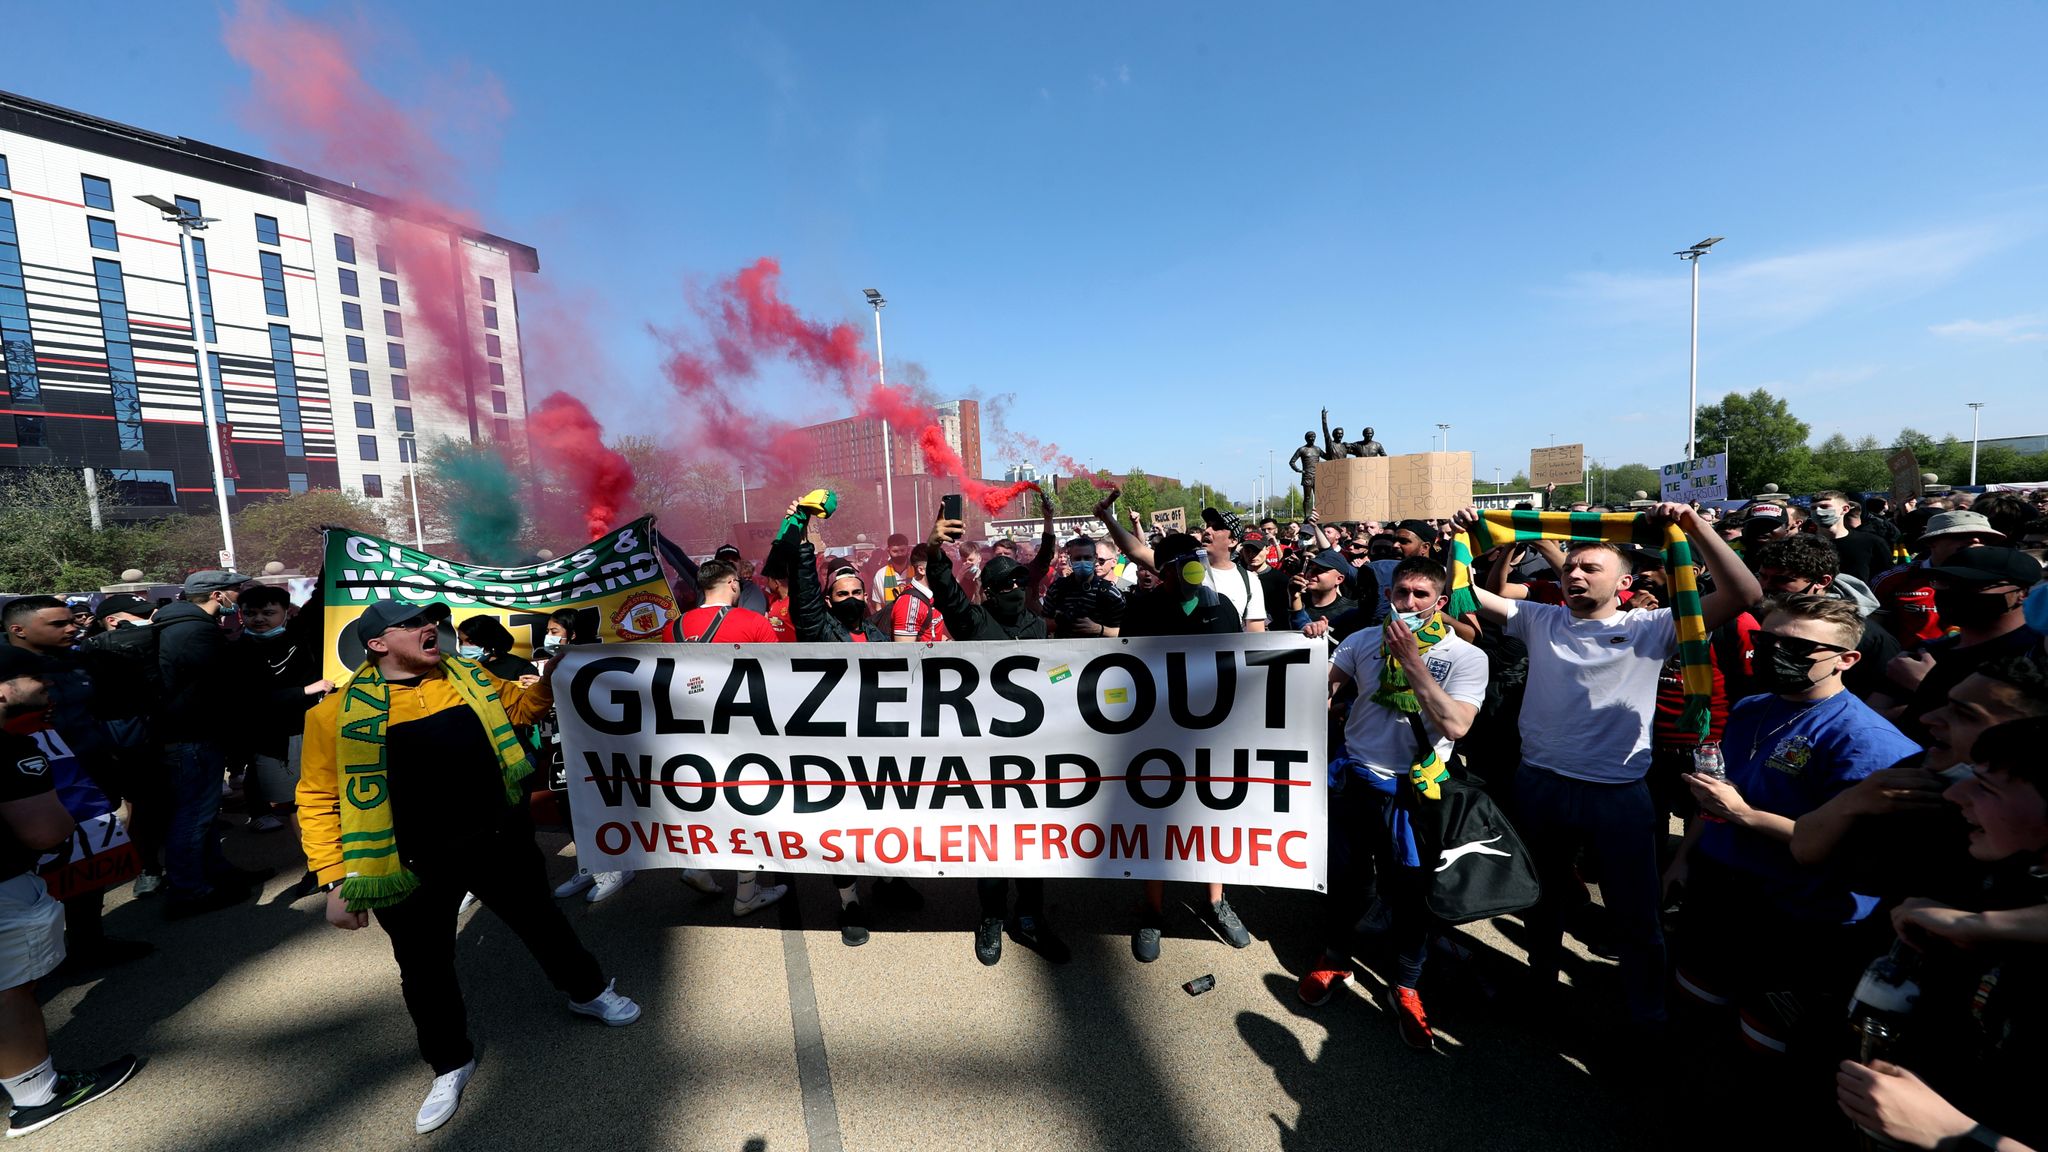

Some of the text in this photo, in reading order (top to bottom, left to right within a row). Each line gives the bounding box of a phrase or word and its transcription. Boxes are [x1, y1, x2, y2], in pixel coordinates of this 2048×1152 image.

[1475, 496, 1510, 509] URGER
[342, 552, 659, 606] WOODWARD
[346, 528, 639, 581] GLAZERS &
[569, 649, 1311, 738] GLAZERS OUT
[583, 747, 1311, 816] WOODWARD OUT
[595, 820, 1309, 870] OVER £1B STOLEN FROM MUFC
